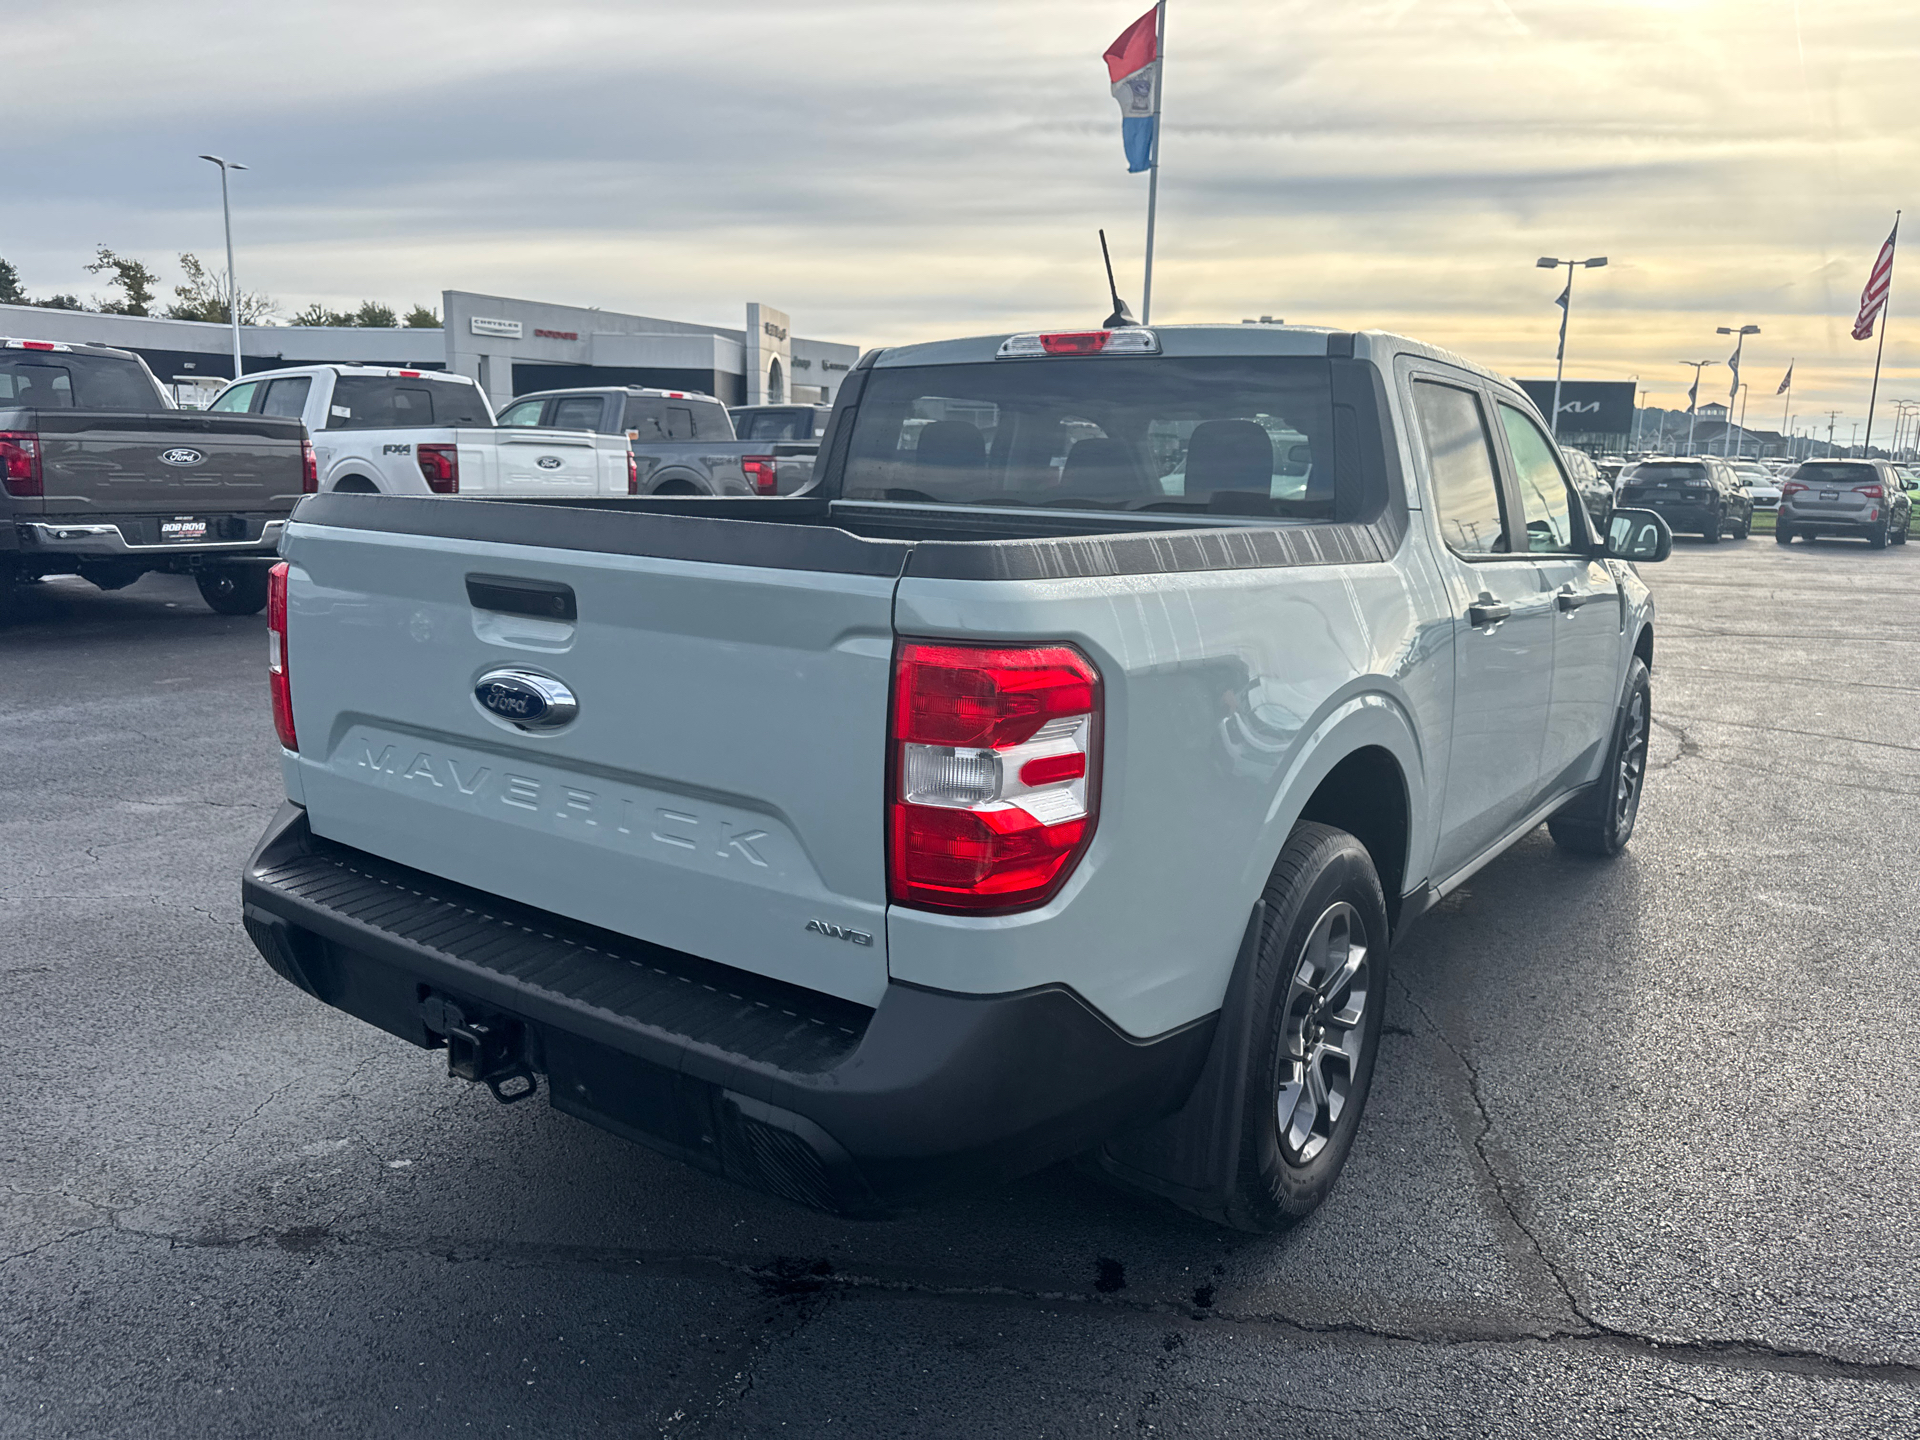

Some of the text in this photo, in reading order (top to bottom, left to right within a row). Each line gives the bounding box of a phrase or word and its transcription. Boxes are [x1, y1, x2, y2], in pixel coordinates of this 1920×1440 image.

[474, 319, 519, 329] CHRYSLER
[534, 328, 578, 341] DODGE
[383, 444, 411, 455] FX4
[169, 450, 195, 462] Ford
[162, 522, 206, 532] BOB BOYD
[486, 682, 530, 715] Ford
[358, 738, 768, 868] MAVERICK
[804, 918, 874, 948] AWD
